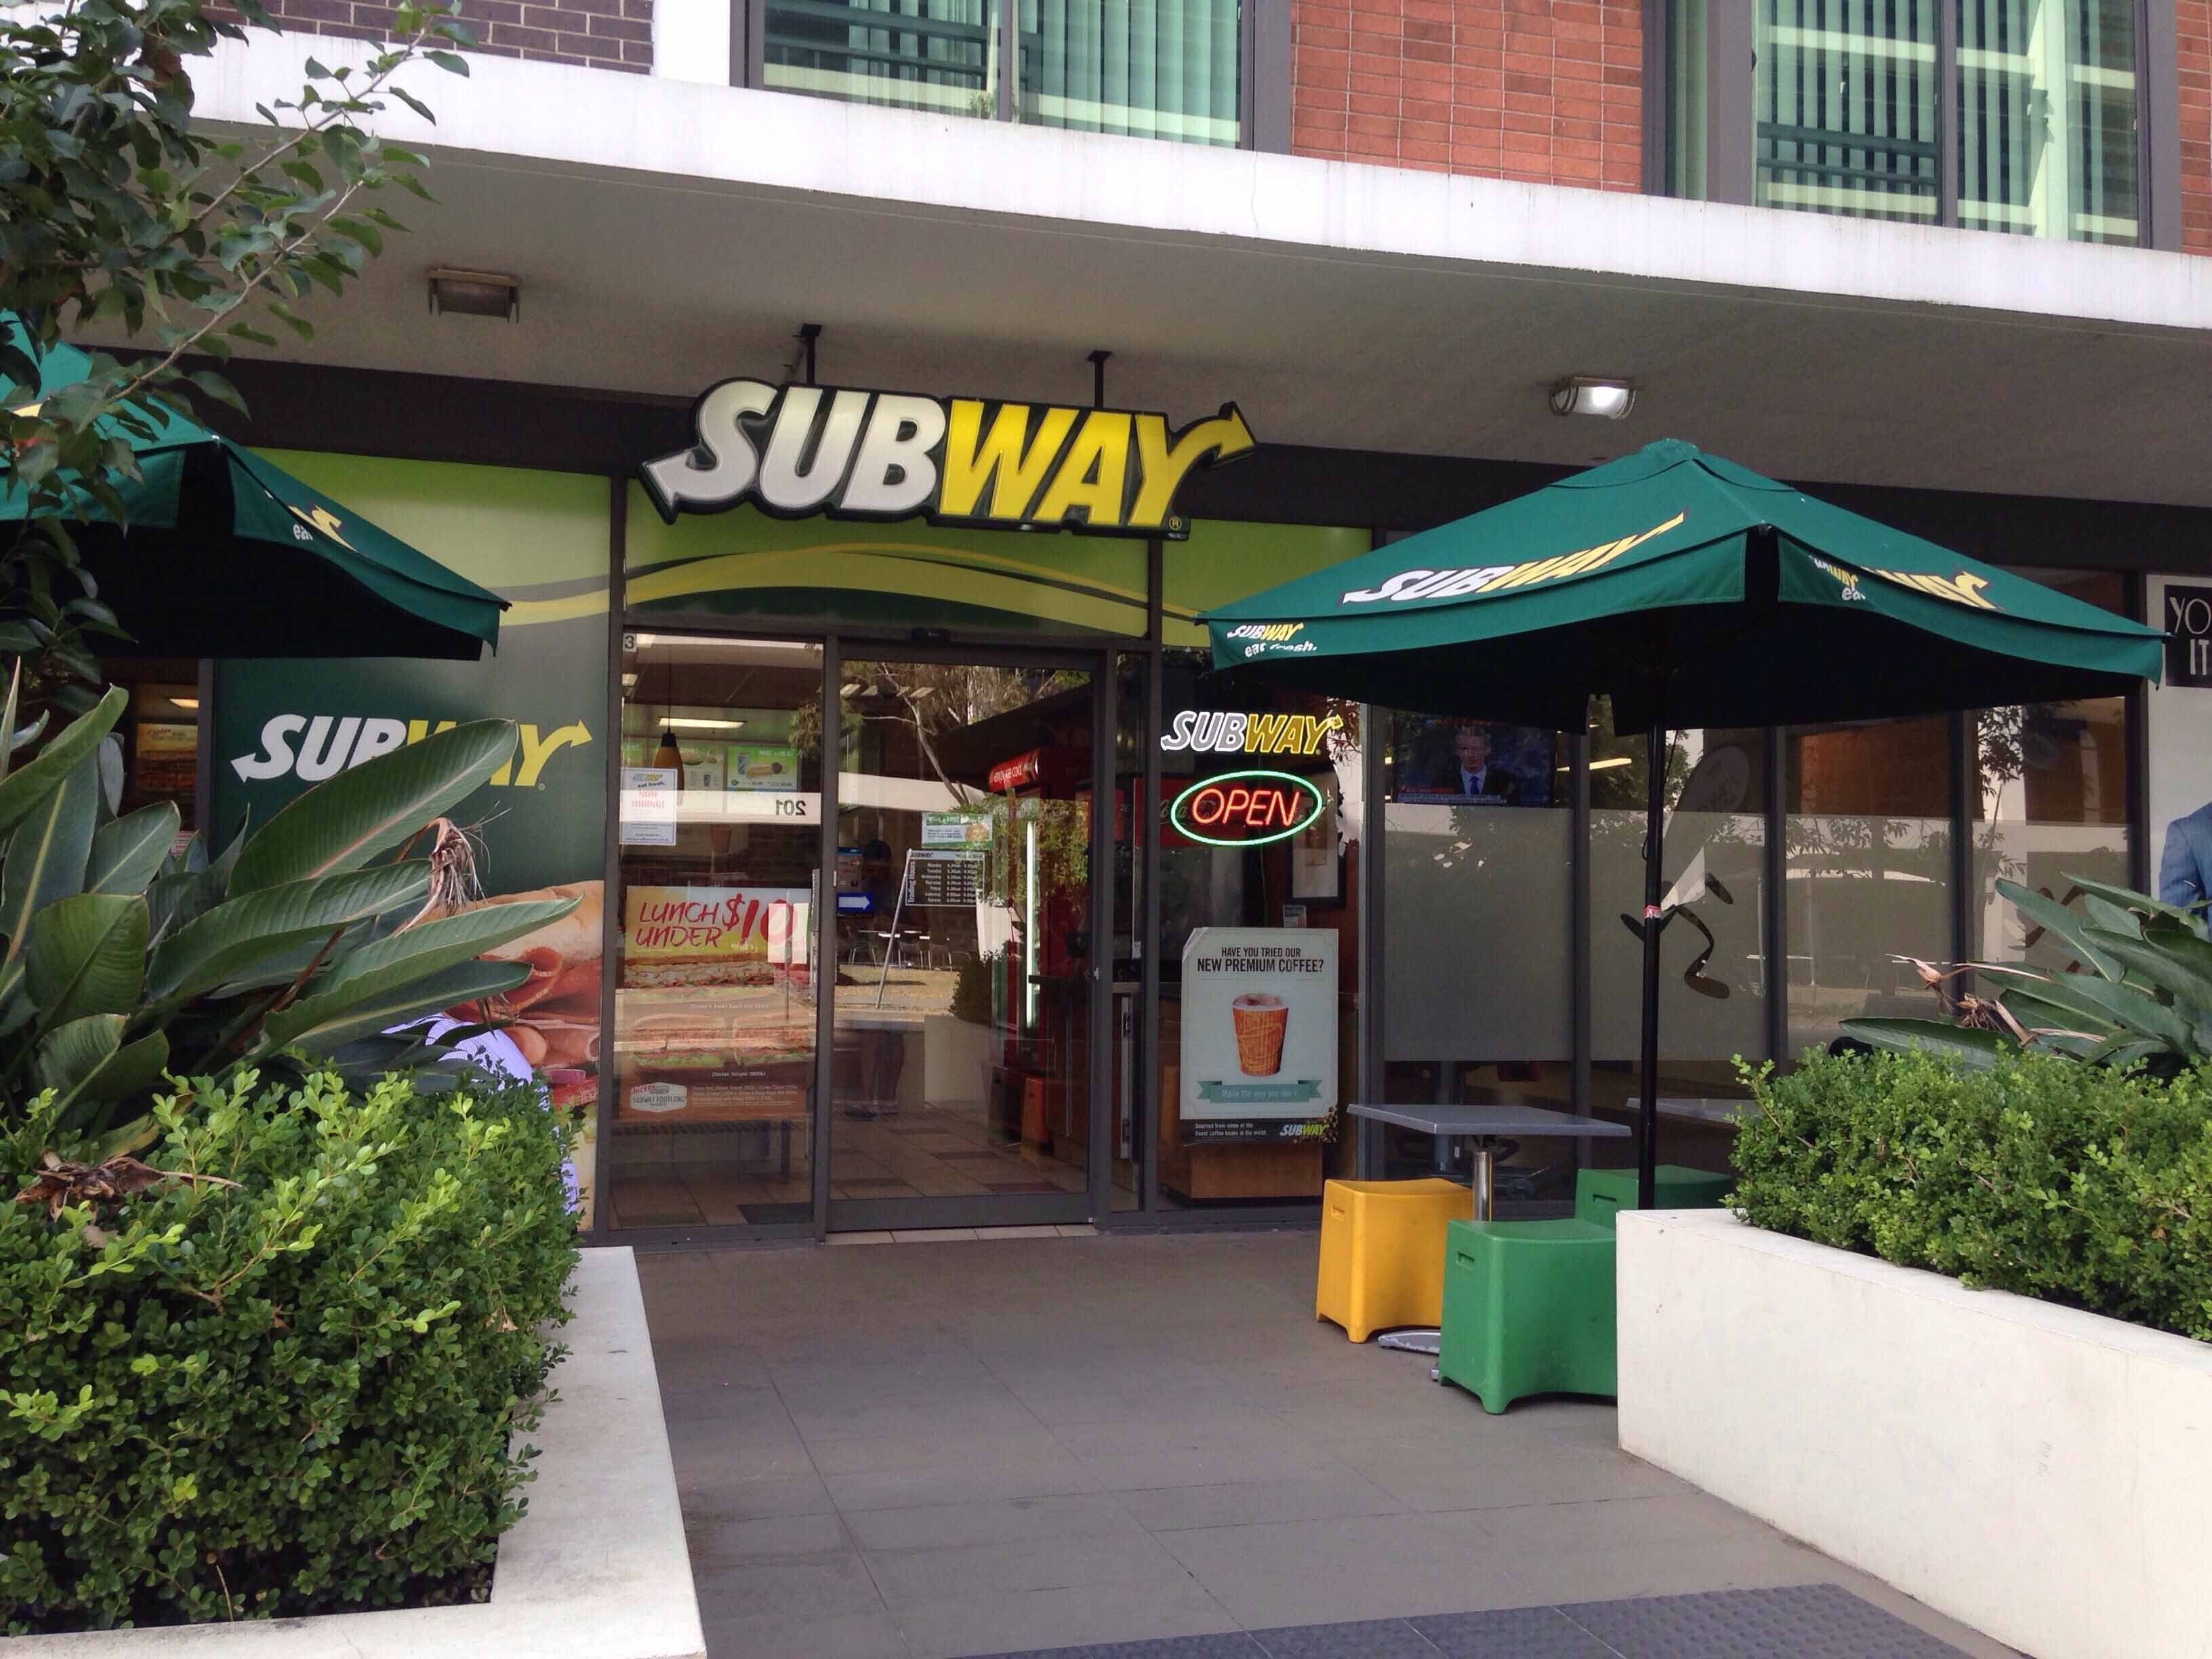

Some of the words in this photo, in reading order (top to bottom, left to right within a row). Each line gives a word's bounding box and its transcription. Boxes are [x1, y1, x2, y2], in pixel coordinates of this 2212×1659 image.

[644, 379, 1256, 527] SUBWAY
[1343, 512, 1685, 603] SUBWAY
[1227, 622, 1305, 641] SUBWAY
[1161, 710, 1343, 754] SUBWAY
[1193, 788, 1300, 825] OPEN
[639, 901, 720, 924] LUNCH
[636, 926, 723, 948] UNDER
[1221, 947, 1242, 957] HAVE
[1244, 947, 1258, 957] YOU
[1261, 947, 1283, 957] TRIED
[1286, 947, 1300, 957] OUR
[1197, 959, 1222, 972] NEW
[1225, 959, 1275, 972] PREMIUM
[1279, 959, 1324, 972] COFFEE?
